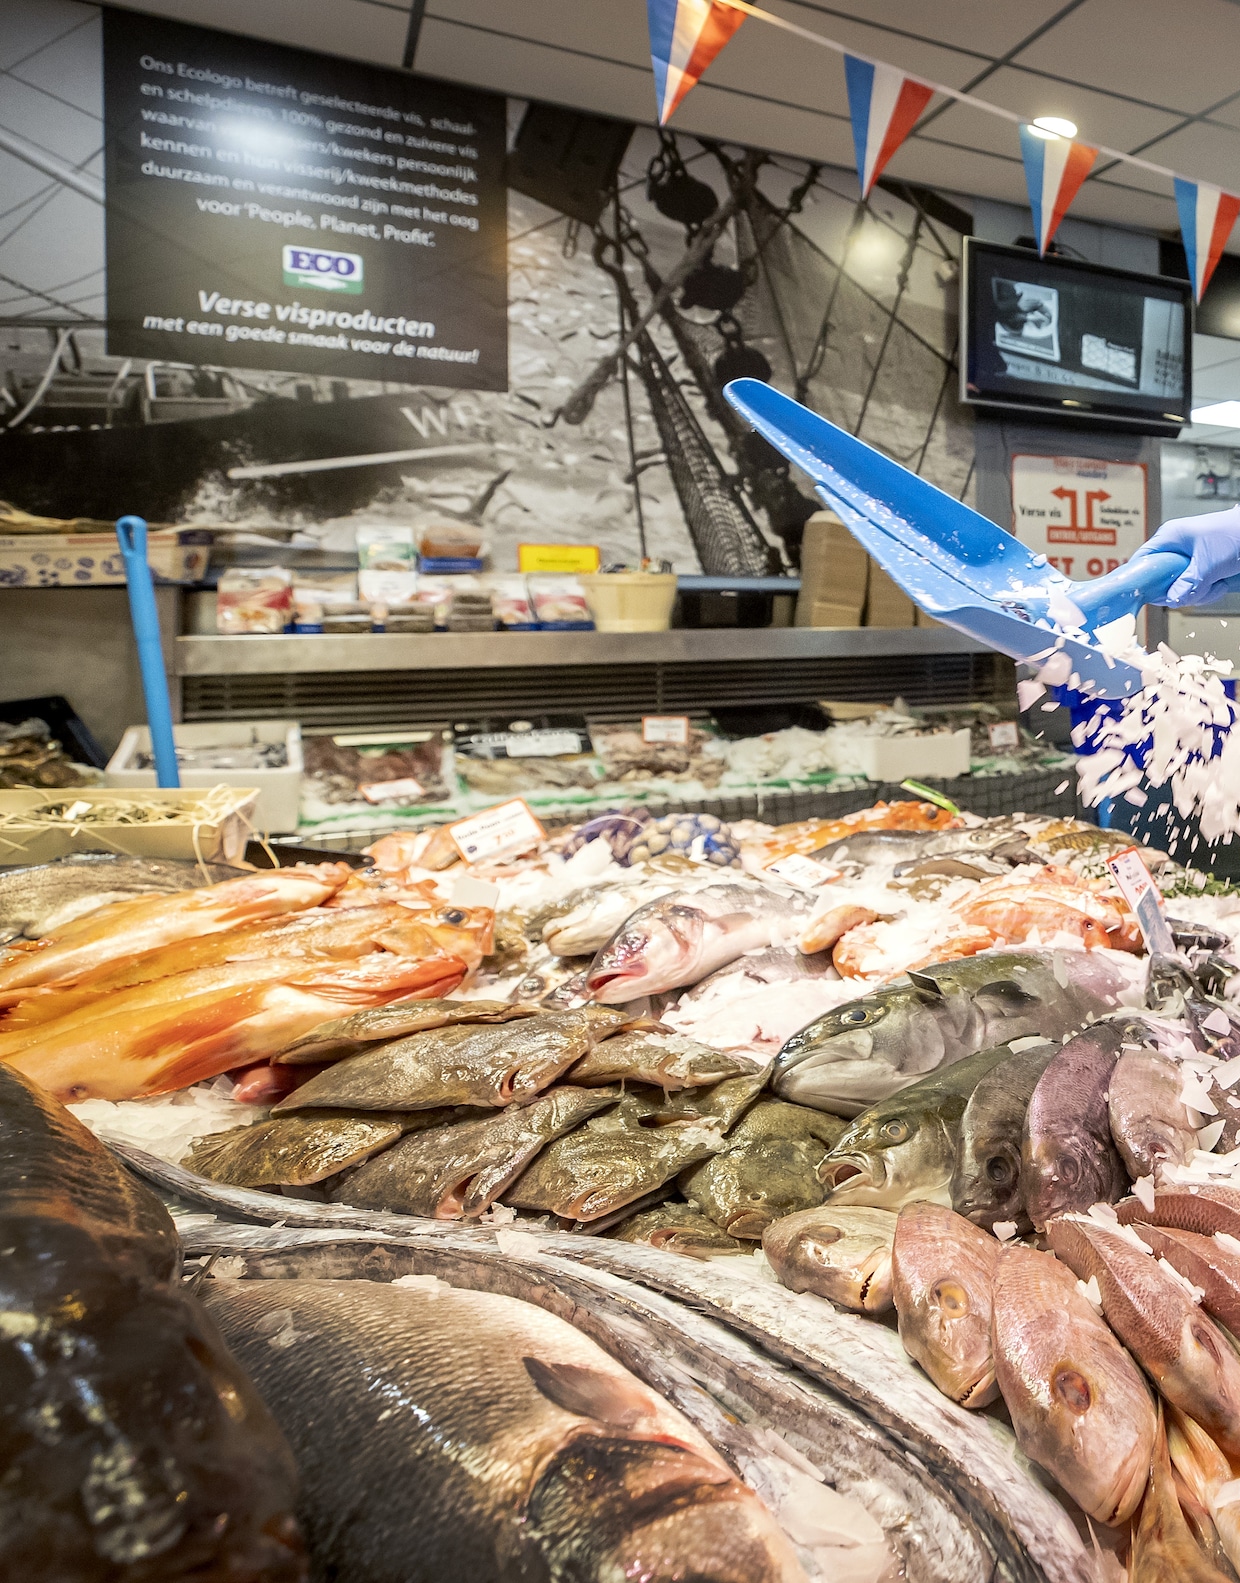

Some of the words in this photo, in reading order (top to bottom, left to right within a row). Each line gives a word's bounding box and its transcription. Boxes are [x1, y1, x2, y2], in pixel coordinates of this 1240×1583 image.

[139, 54, 175, 75] Ons
[176, 62, 243, 89] Ecologo
[245, 77, 298, 100] betreft
[300, 91, 401, 121] geselecteerde
[139, 82, 163, 98] en
[280, 108, 325, 129] 100%
[325, 119, 383, 141] gezond
[384, 131, 405, 145] en
[405, 135, 458, 155] zuivere
[458, 145, 479, 160] vis
[140, 109, 216, 132] waarvan
[396, 157, 478, 183] persoonlijk
[140, 131, 212, 159] kennen
[215, 150, 240, 163] en
[243, 151, 281, 170] hun
[140, 159, 230, 187] duurzaam
[231, 177, 255, 191] en
[256, 182, 360, 210] verantwoord
[360, 198, 389, 216] zijn
[390, 203, 421, 220] met
[422, 206, 449, 224] het
[449, 213, 480, 232] oog
[196, 197, 242, 217] voor
[320, 214, 382, 241] Planet,
[290, 250, 356, 276] ECO
[198, 289, 272, 320] Verse
[275, 301, 436, 339] visproducten
[143, 315, 185, 333] met
[186, 320, 224, 337] een
[225, 325, 287, 343] goede
[287, 330, 349, 351] smaak
[350, 338, 393, 355] voor
[392, 340, 416, 358] de
[416, 345, 480, 365] natuur!
[1019, 504, 1046, 518] Verse
[1049, 507, 1062, 518] vis
[1047, 556, 1074, 576] ET
